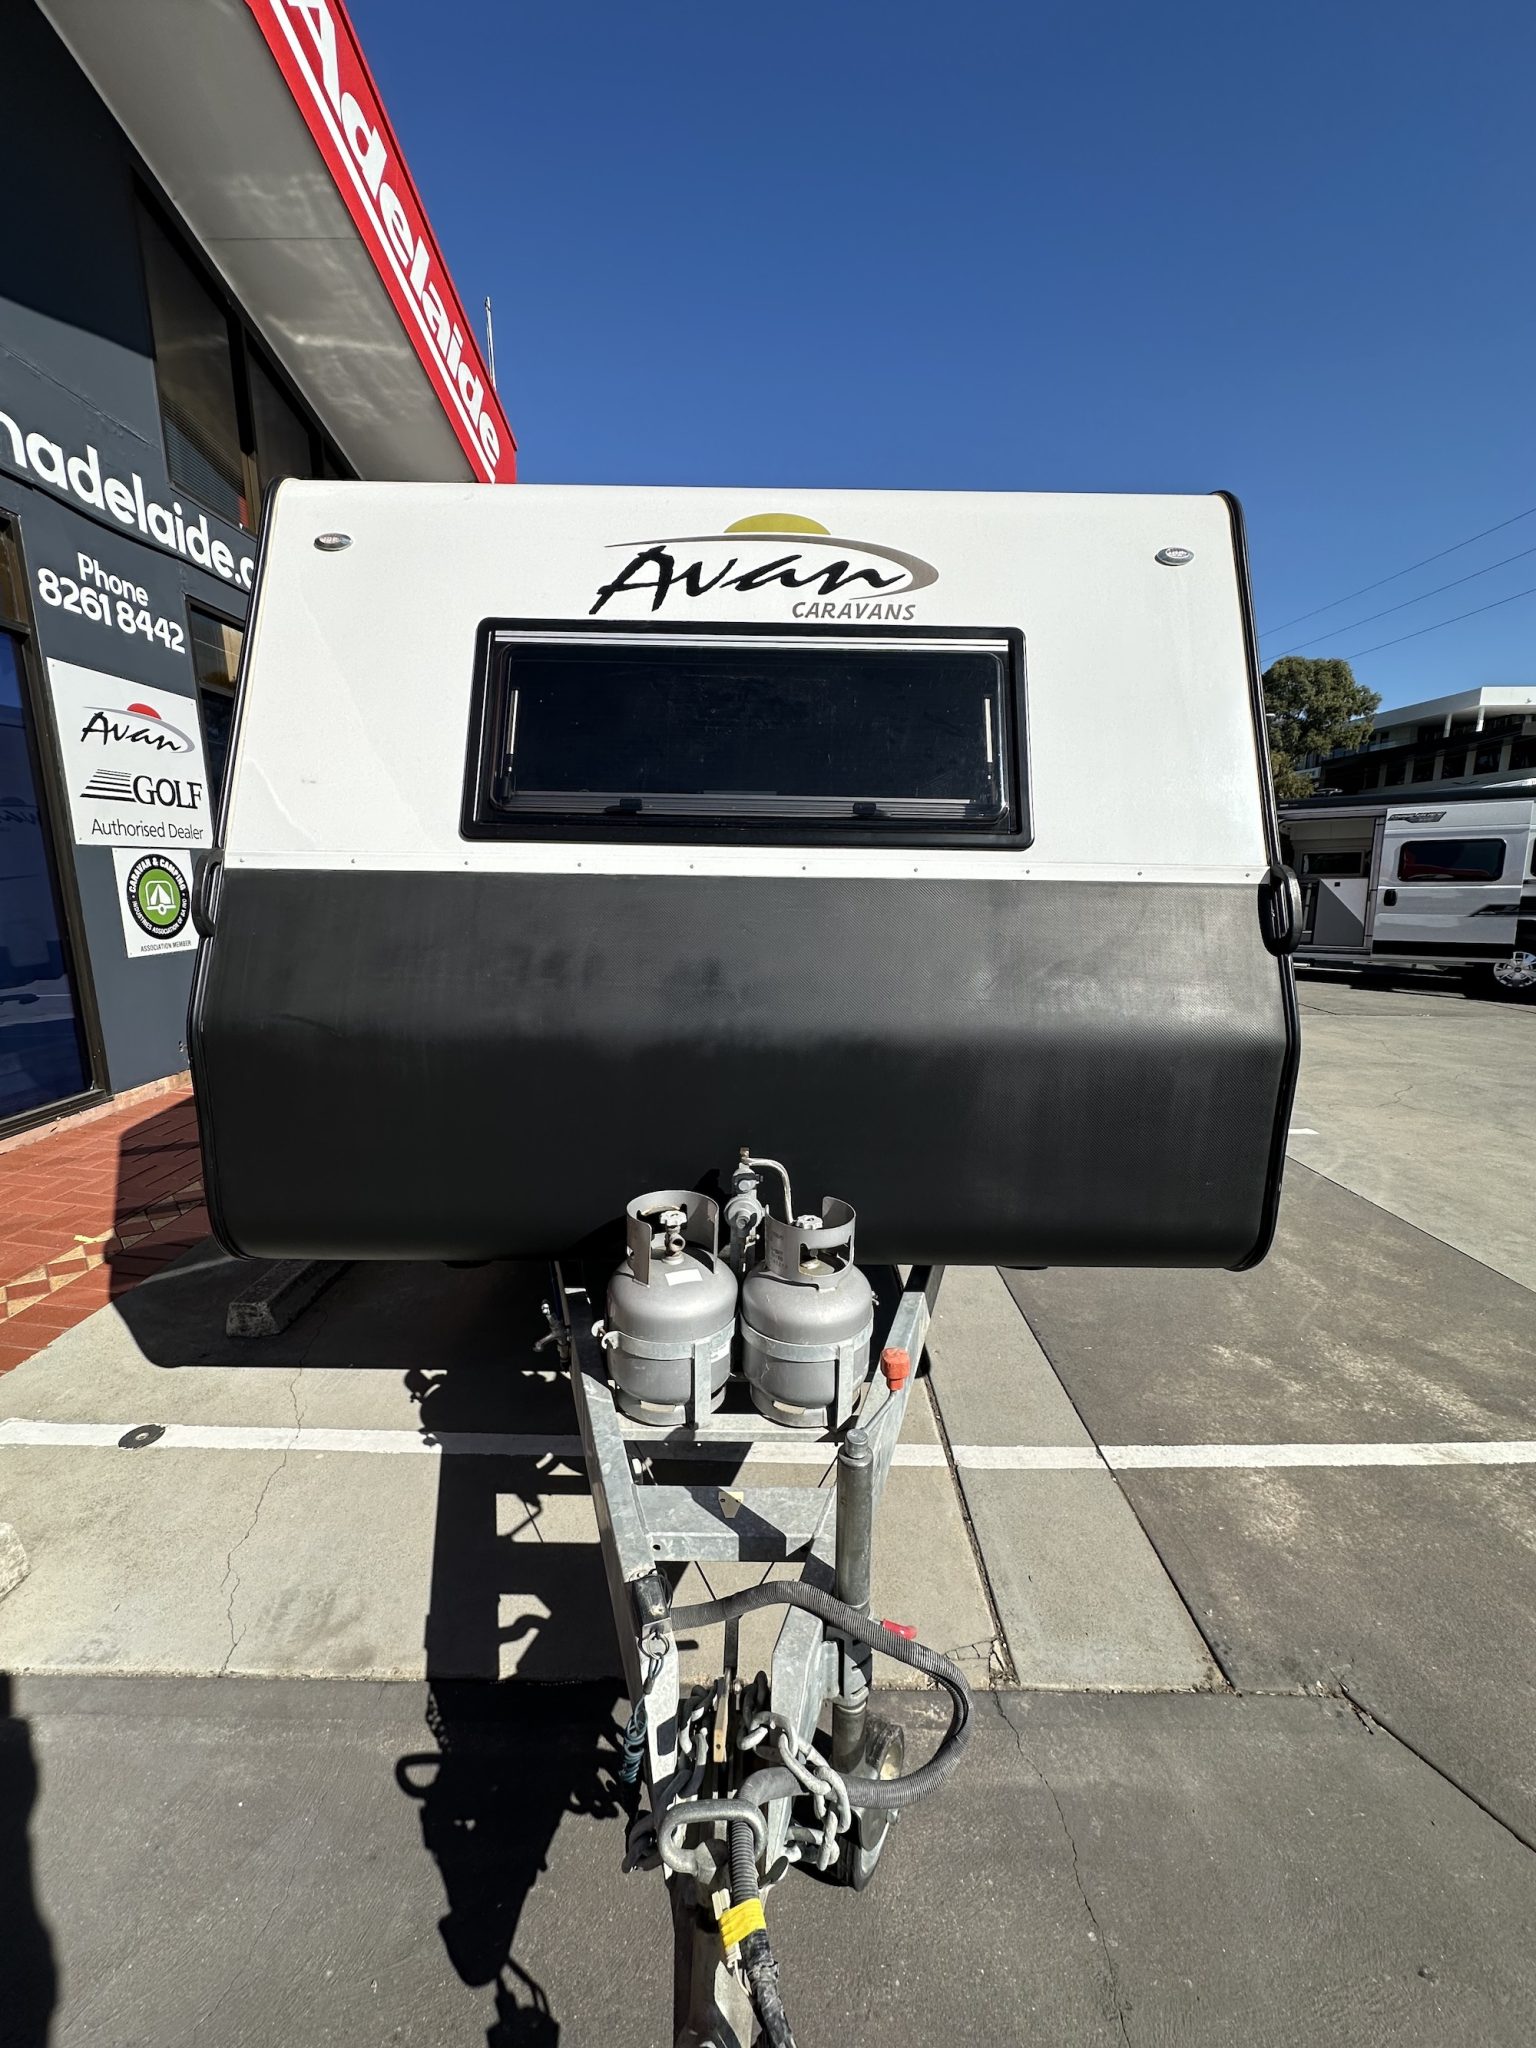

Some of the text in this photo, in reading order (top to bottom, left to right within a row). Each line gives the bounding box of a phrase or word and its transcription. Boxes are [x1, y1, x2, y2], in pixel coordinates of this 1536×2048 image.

[286, 0, 500, 467] Adelaide
[77, 552, 149, 607] Phone
[589, 545, 906, 615] Avan
[38, 567, 185, 654] 8261 8442
[792, 601, 916, 621] CARAVANS
[80, 711, 182, 752] Avan
[133, 775, 202, 809] GOLF
[92, 819, 204, 840] Authorised Dealer
[129, 857, 186, 893] CARAVAN & CAMPING
[141, 940, 192, 952] ASSOCIATION MEMBER
